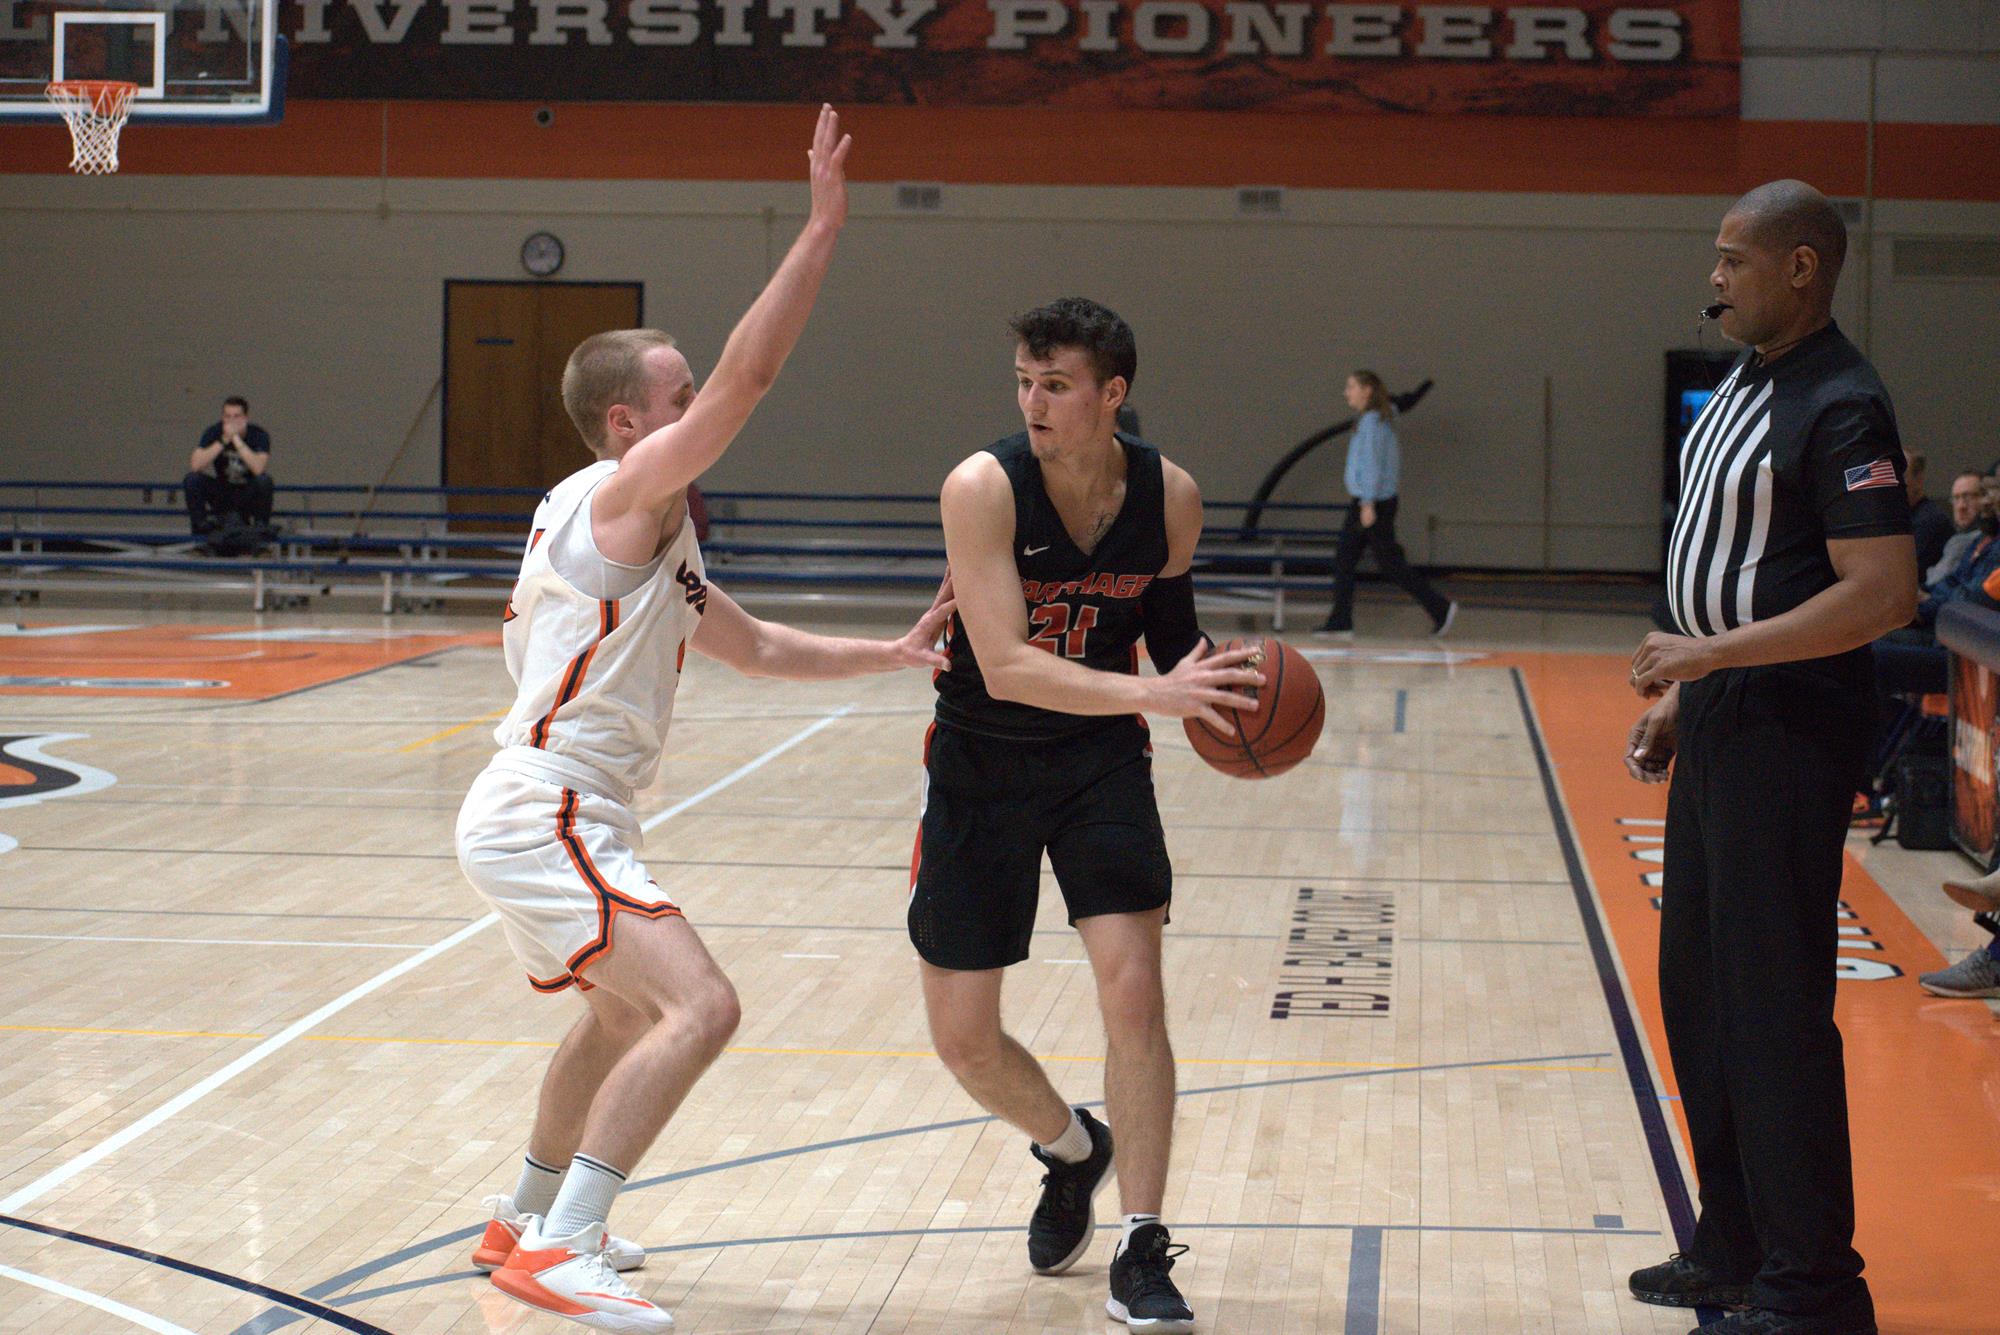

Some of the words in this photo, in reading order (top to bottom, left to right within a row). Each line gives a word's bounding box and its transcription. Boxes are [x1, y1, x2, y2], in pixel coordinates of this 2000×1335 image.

[985, 0, 1682, 61] PIONEERS
[1026, 602, 1099, 659] 21
[1270, 990, 1390, 1020] TED
